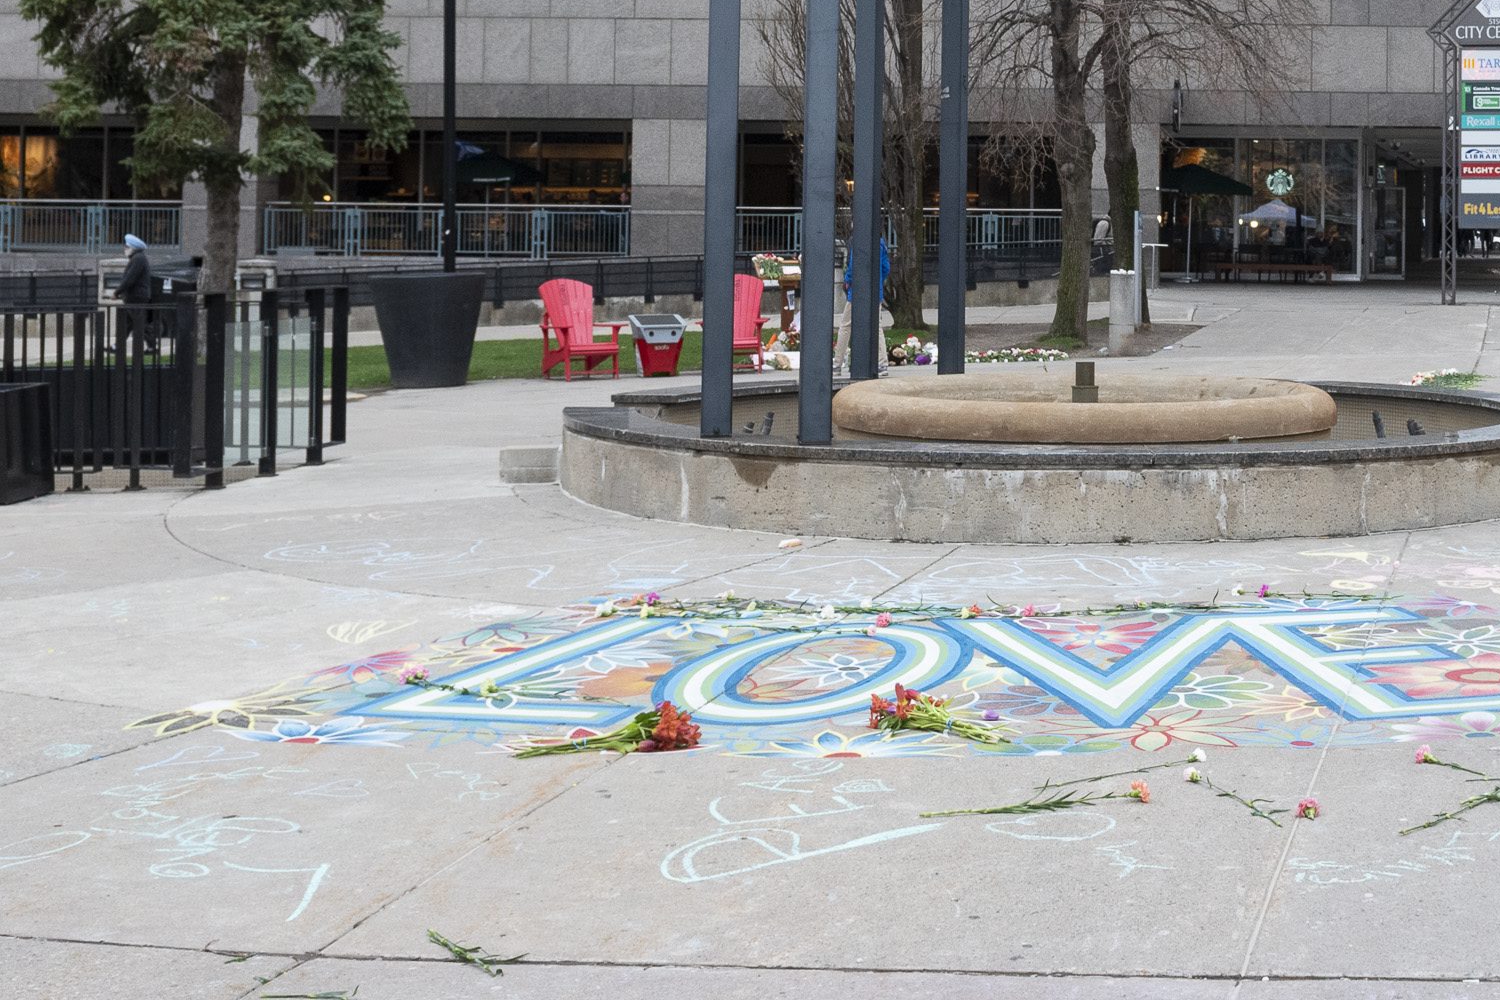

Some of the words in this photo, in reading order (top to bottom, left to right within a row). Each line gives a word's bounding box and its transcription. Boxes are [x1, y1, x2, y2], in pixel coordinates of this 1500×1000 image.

[1455, 25, 1484, 39] CITY
[1466, 115, 1495, 126] Rexall
[1463, 166, 1493, 174] FLIGHT
